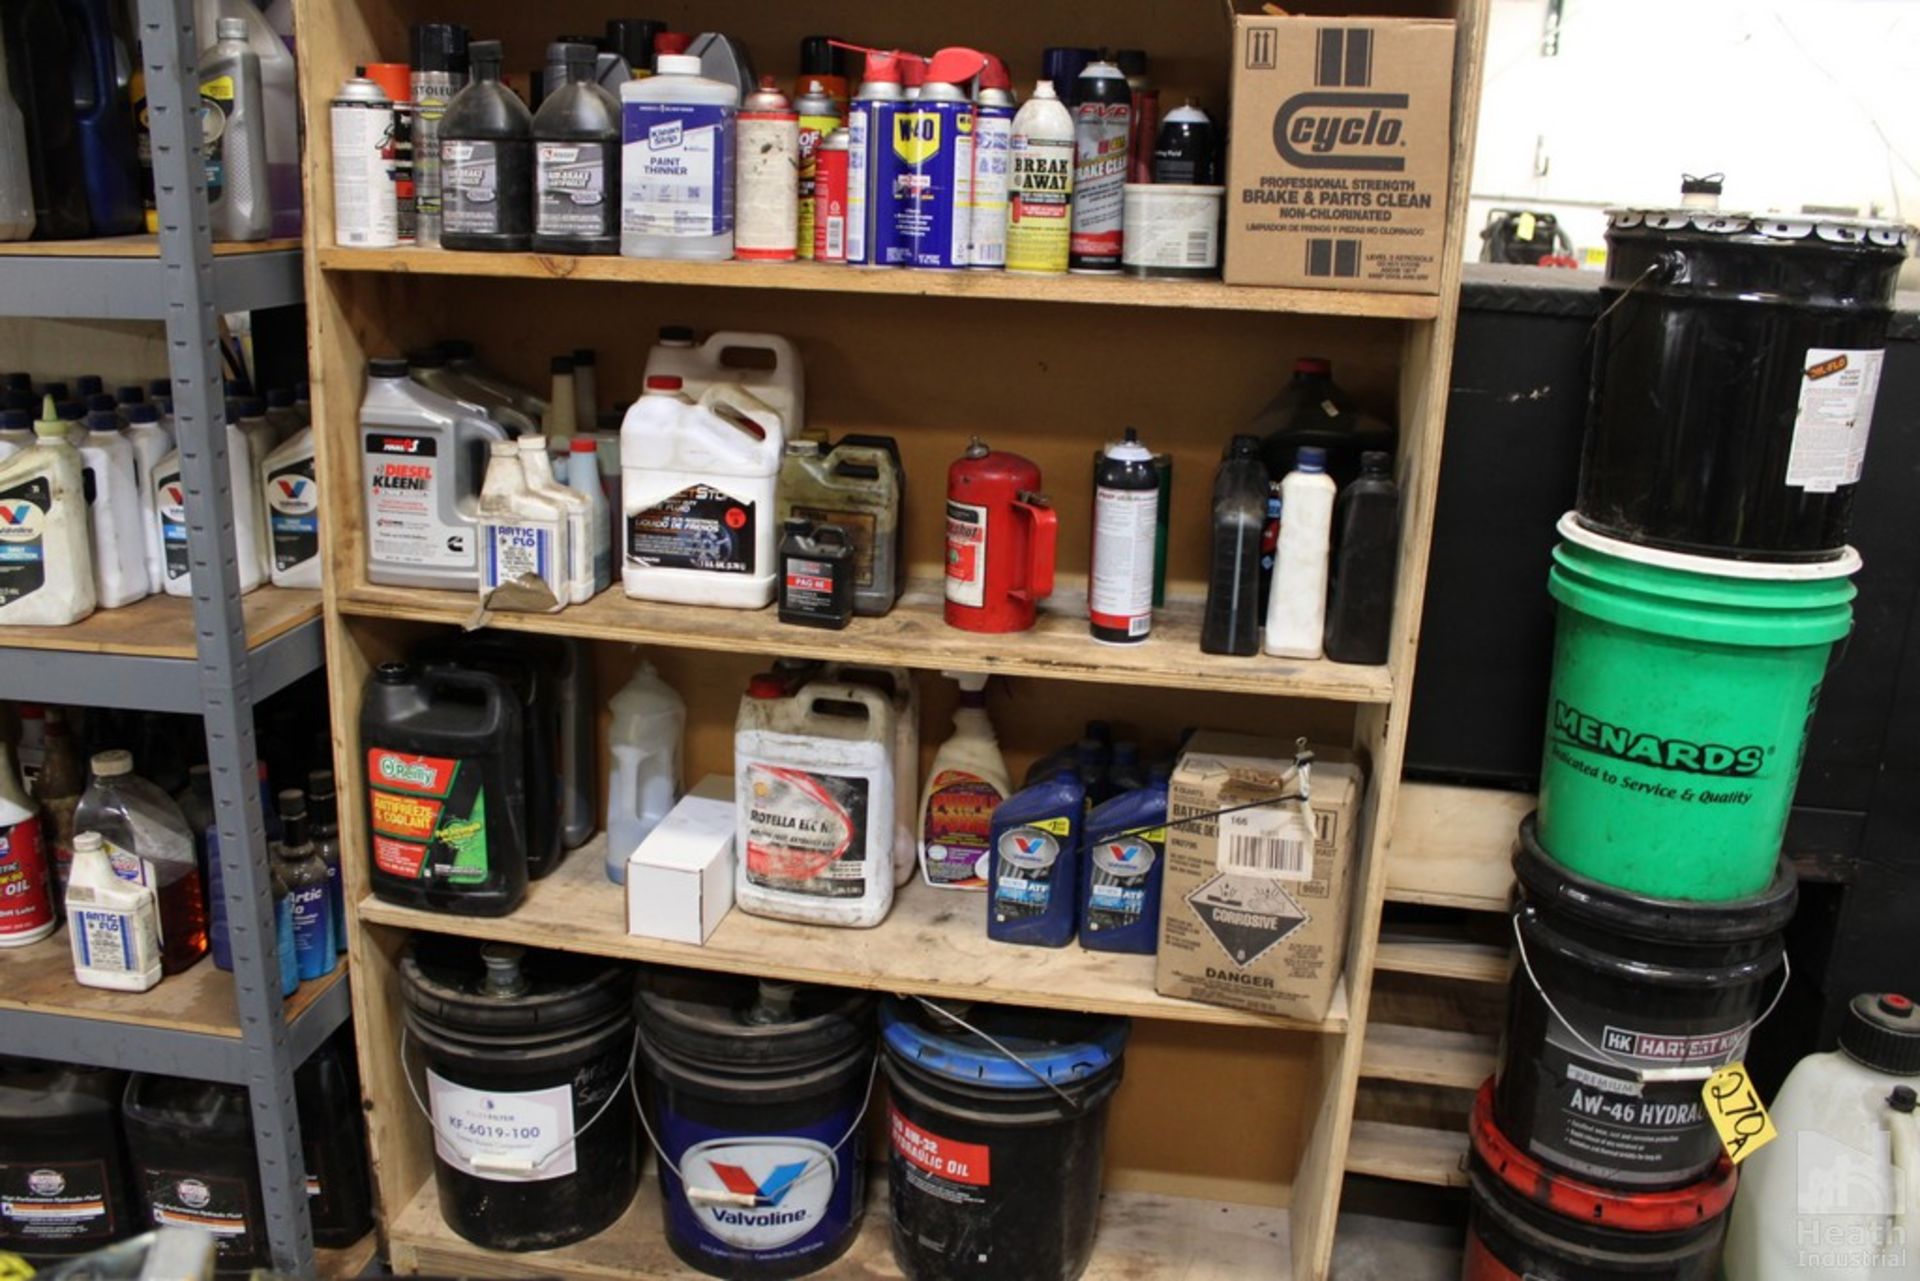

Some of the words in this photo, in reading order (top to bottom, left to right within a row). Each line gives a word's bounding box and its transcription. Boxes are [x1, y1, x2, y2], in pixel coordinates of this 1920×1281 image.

[644, 165, 688, 175] THINNER
[650, 157, 681, 166] PAINT
[1014, 157, 1069, 173] BREAK
[1022, 174, 1068, 190] AWAY
[1260, 176, 1349, 190] PROFESSIONAL
[1352, 179, 1415, 192] STRENGTH
[1242, 189, 1299, 205] BRAKE
[1303, 191, 1316, 206] &
[1319, 192, 1372, 207] PARTS
[1376, 192, 1432, 209] CLEAN
[1280, 207, 1392, 222] NON-CHLORINATED
[1553, 700, 1764, 776] MENARDS
[1602, 770, 1618, 785] to
[1622, 776, 1677, 800] Service
[1680, 788, 1695, 802] &
[1699, 790, 1752, 806] Quality
[750, 809, 796, 829] ROTELLA
[6, 879, 31, 896] OIL
[1212, 907, 1279, 931] CORROSIVE
[1206, 967, 1275, 989] DANGER
[1607, 1032, 1632, 1052] HK
[1640, 1037, 1721, 1057] HARVEST
[1575, 1069, 1633, 1091] PREMIUM
[1570, 1088, 1636, 1122] AW-46
[449, 1115, 540, 1138] KF-6019-100
[947, 1160, 970, 1178] OIL
[711, 1206, 807, 1227] Valvoline
